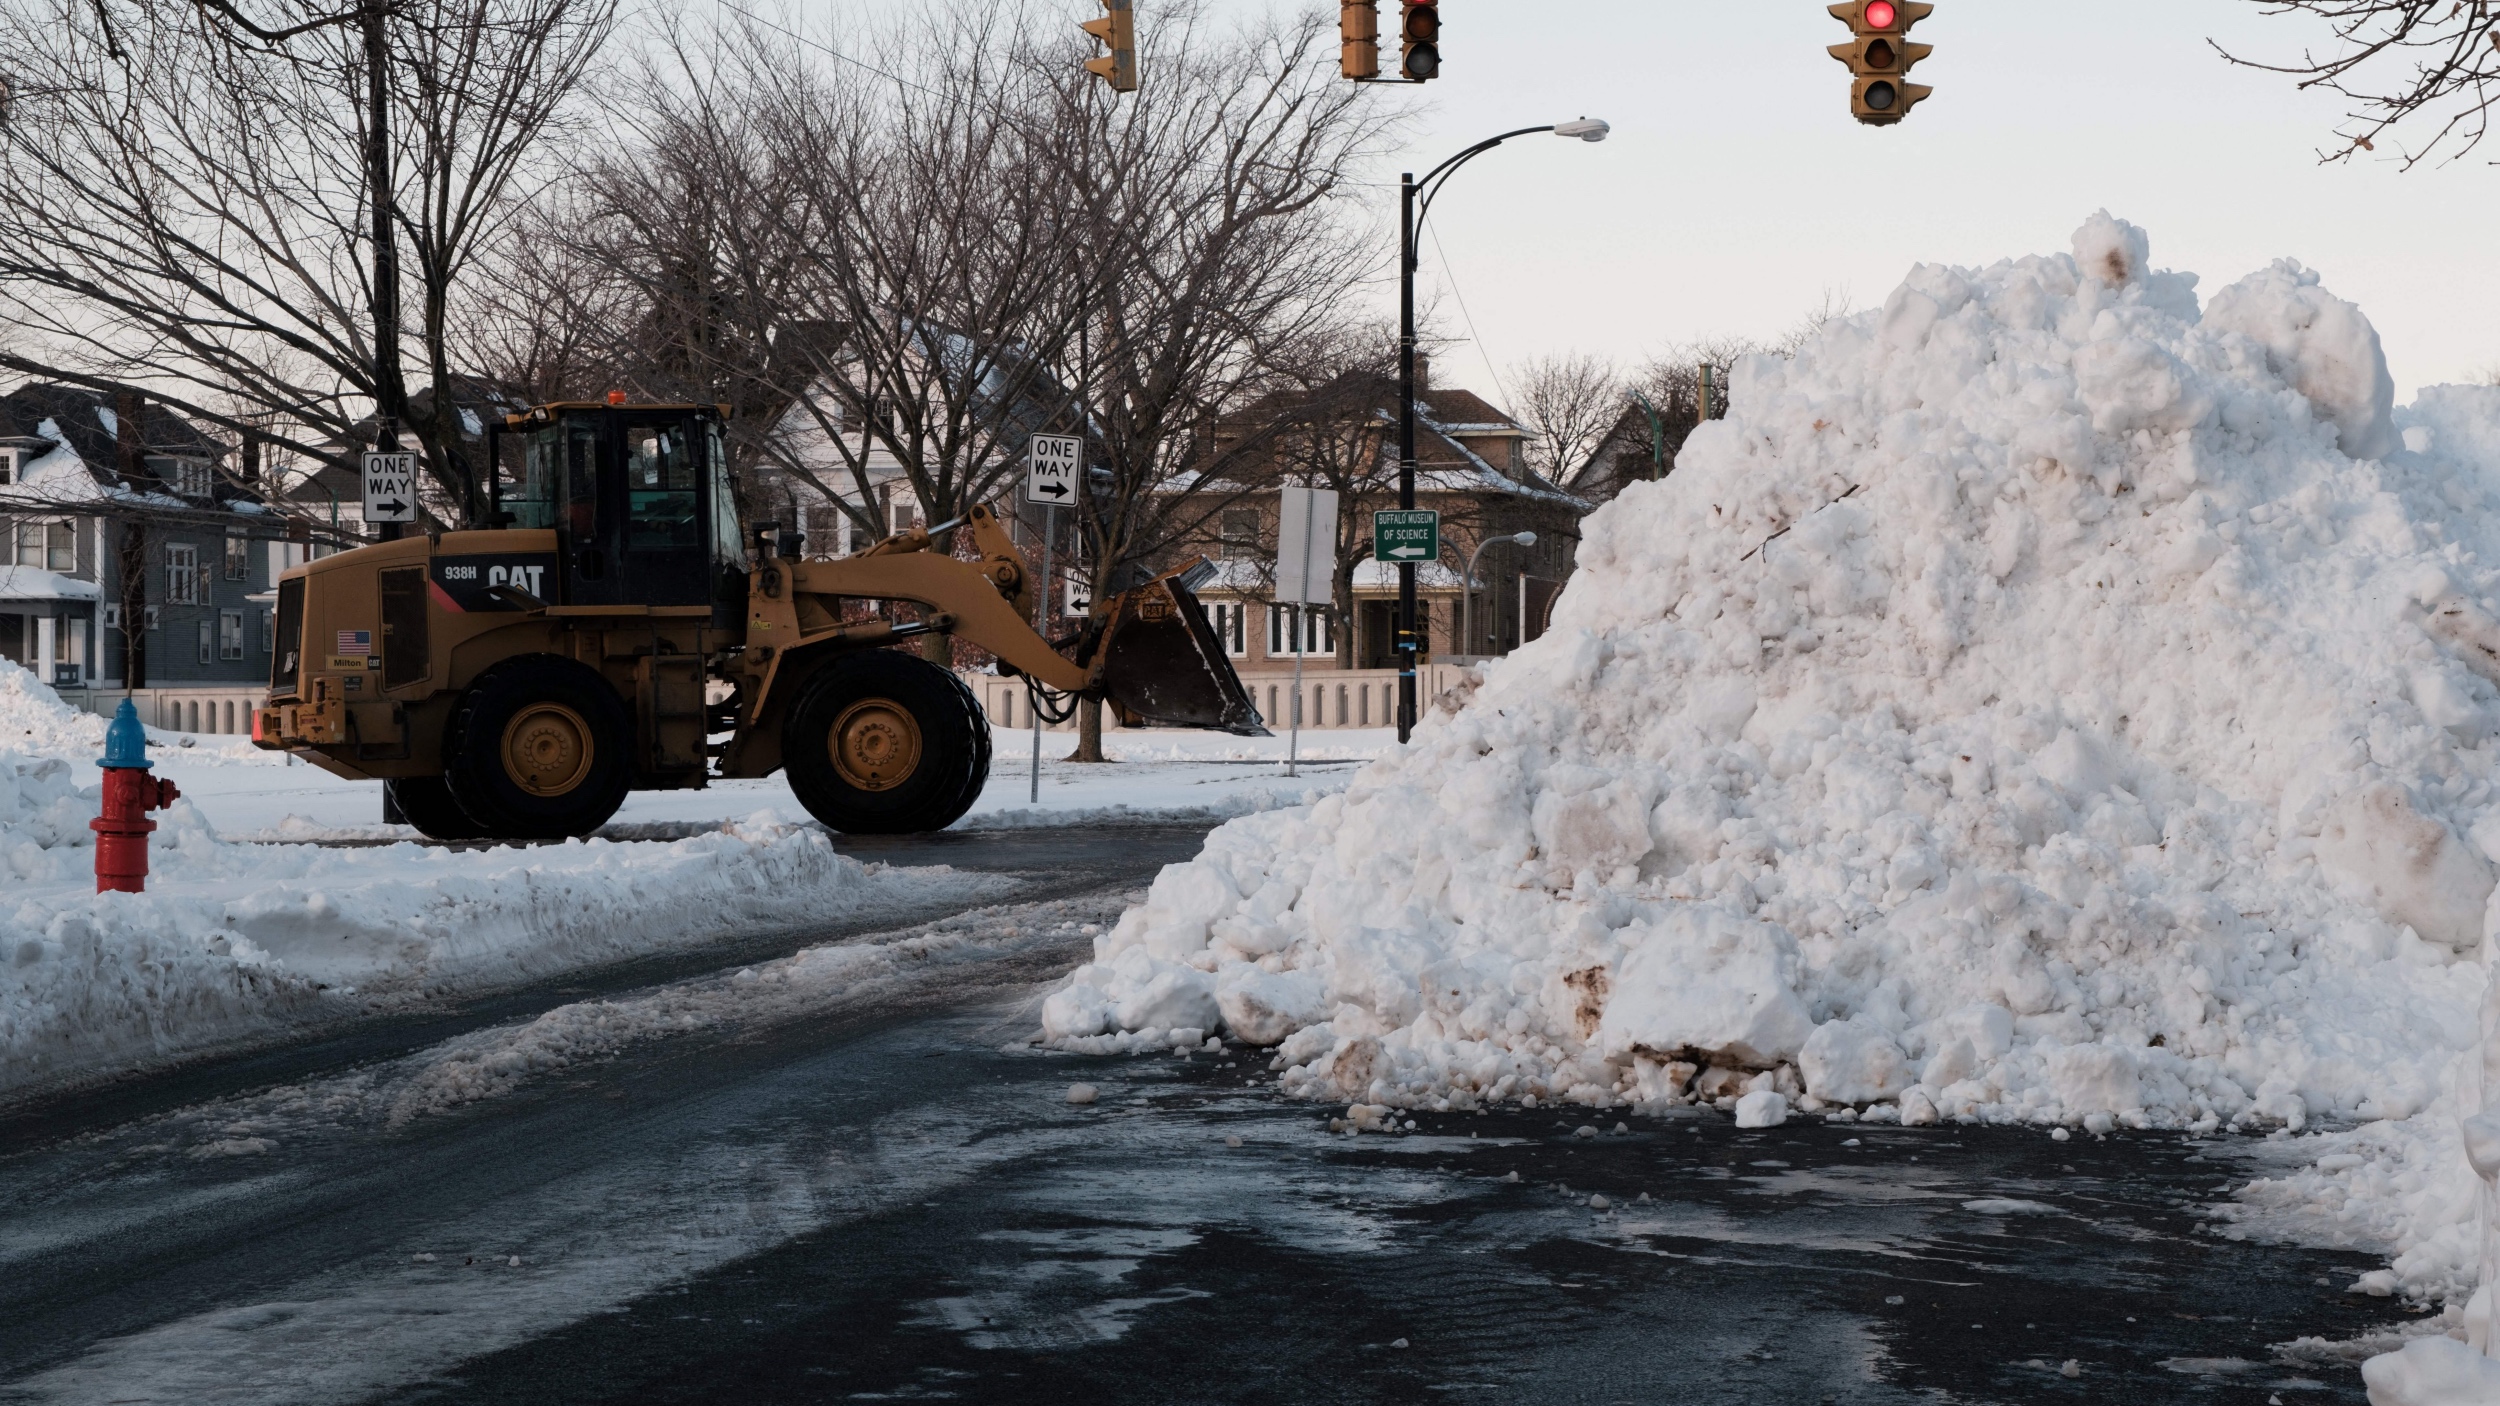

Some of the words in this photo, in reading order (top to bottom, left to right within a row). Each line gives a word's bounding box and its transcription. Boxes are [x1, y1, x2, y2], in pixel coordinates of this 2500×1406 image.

[1037, 440, 1074, 458] ONE
[370, 457, 408, 473] ONE
[1035, 459, 1073, 477] WAY
[369, 478, 410, 494] WAY
[1378, 514, 1406, 524] BUFFALO
[1408, 513, 1433, 524] MUSEUM
[1384, 529, 1394, 540] OF
[1396, 529, 1428, 540] SCIENCE
[445, 566, 477, 579] 938H
[488, 565, 544, 600] CAT
[1073, 584, 1091, 595] WA
[334, 659, 361, 667] Milton
[368, 659, 380, 667] CAT
